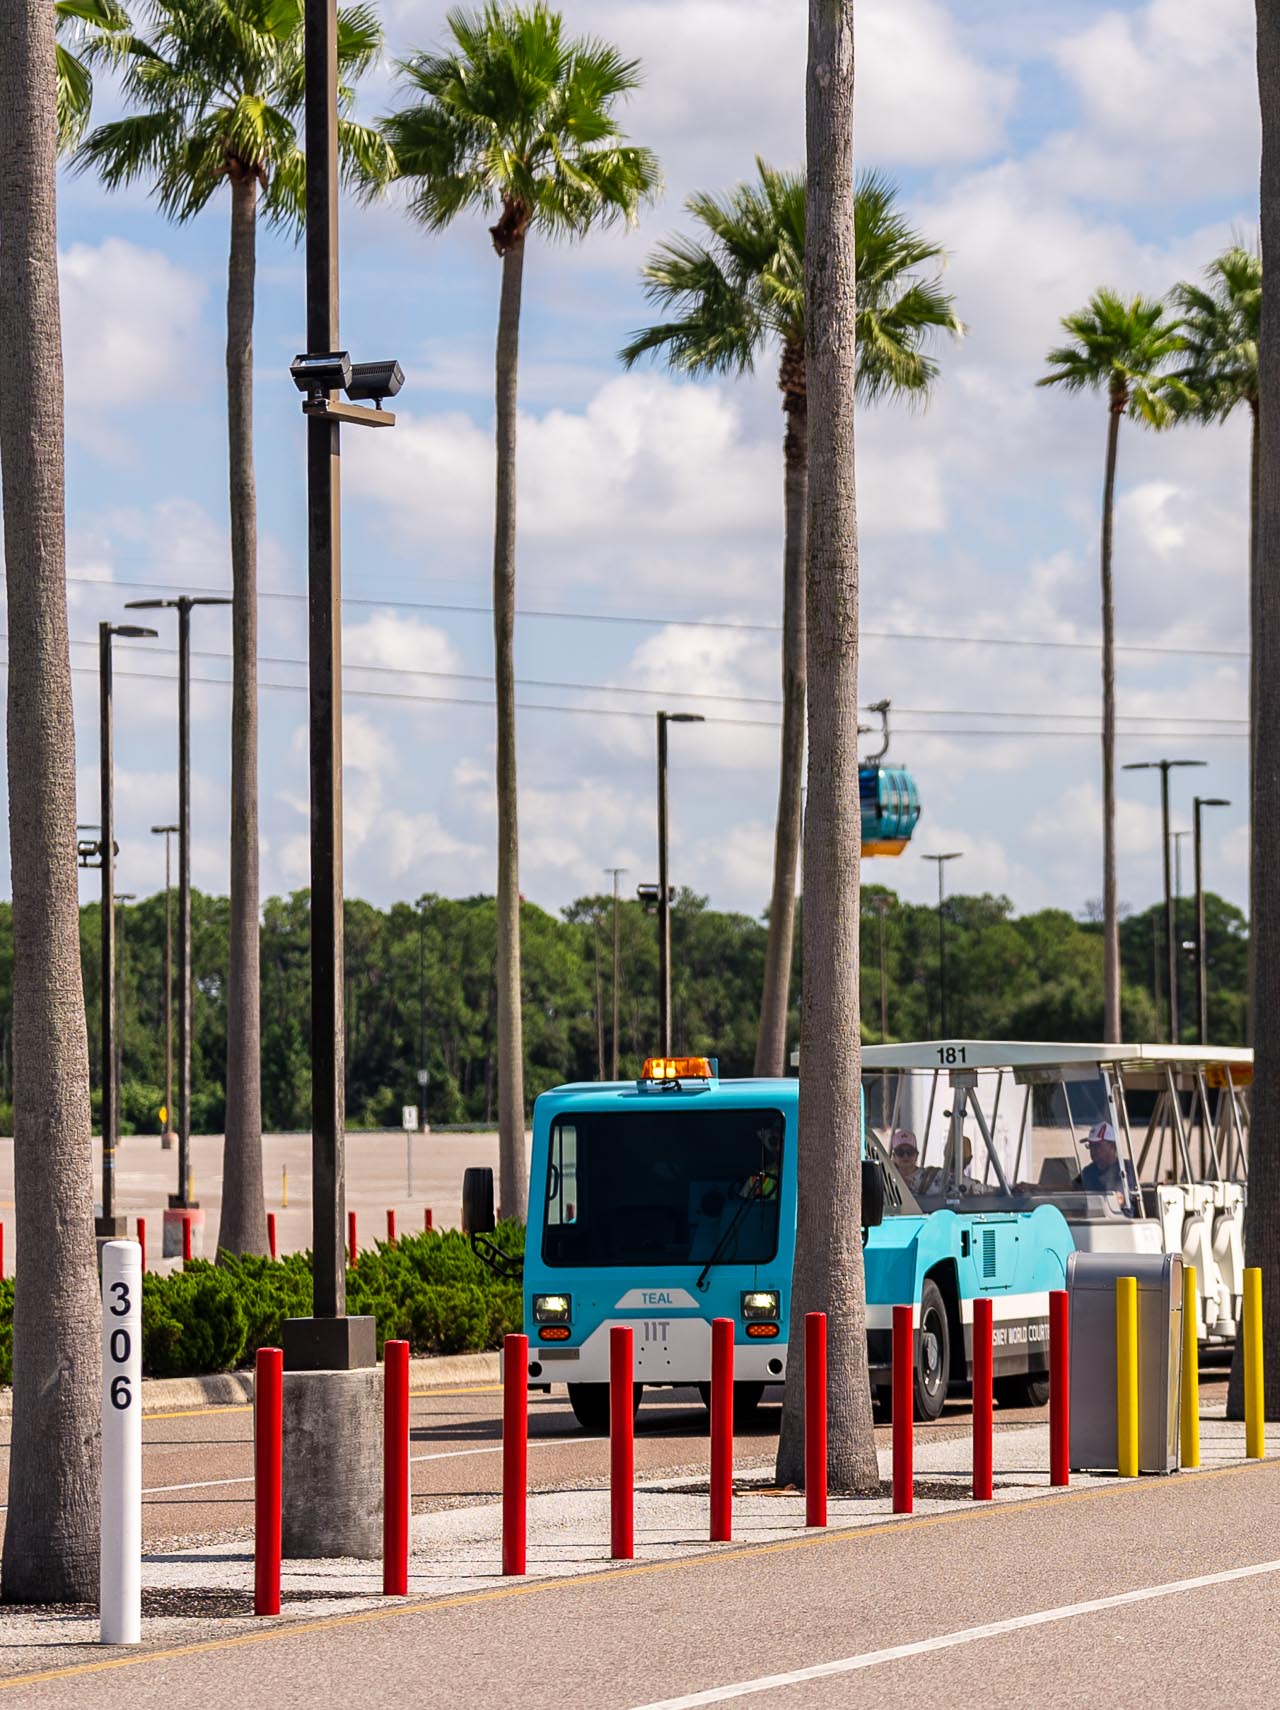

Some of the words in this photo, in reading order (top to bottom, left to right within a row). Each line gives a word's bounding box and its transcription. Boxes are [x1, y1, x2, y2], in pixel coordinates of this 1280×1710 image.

[936, 1046, 966, 1064] 181
[641, 1292, 673, 1305] TEAL
[1008, 1327, 1027, 1344] WORLD
[109, 1281, 132, 1410] 306
